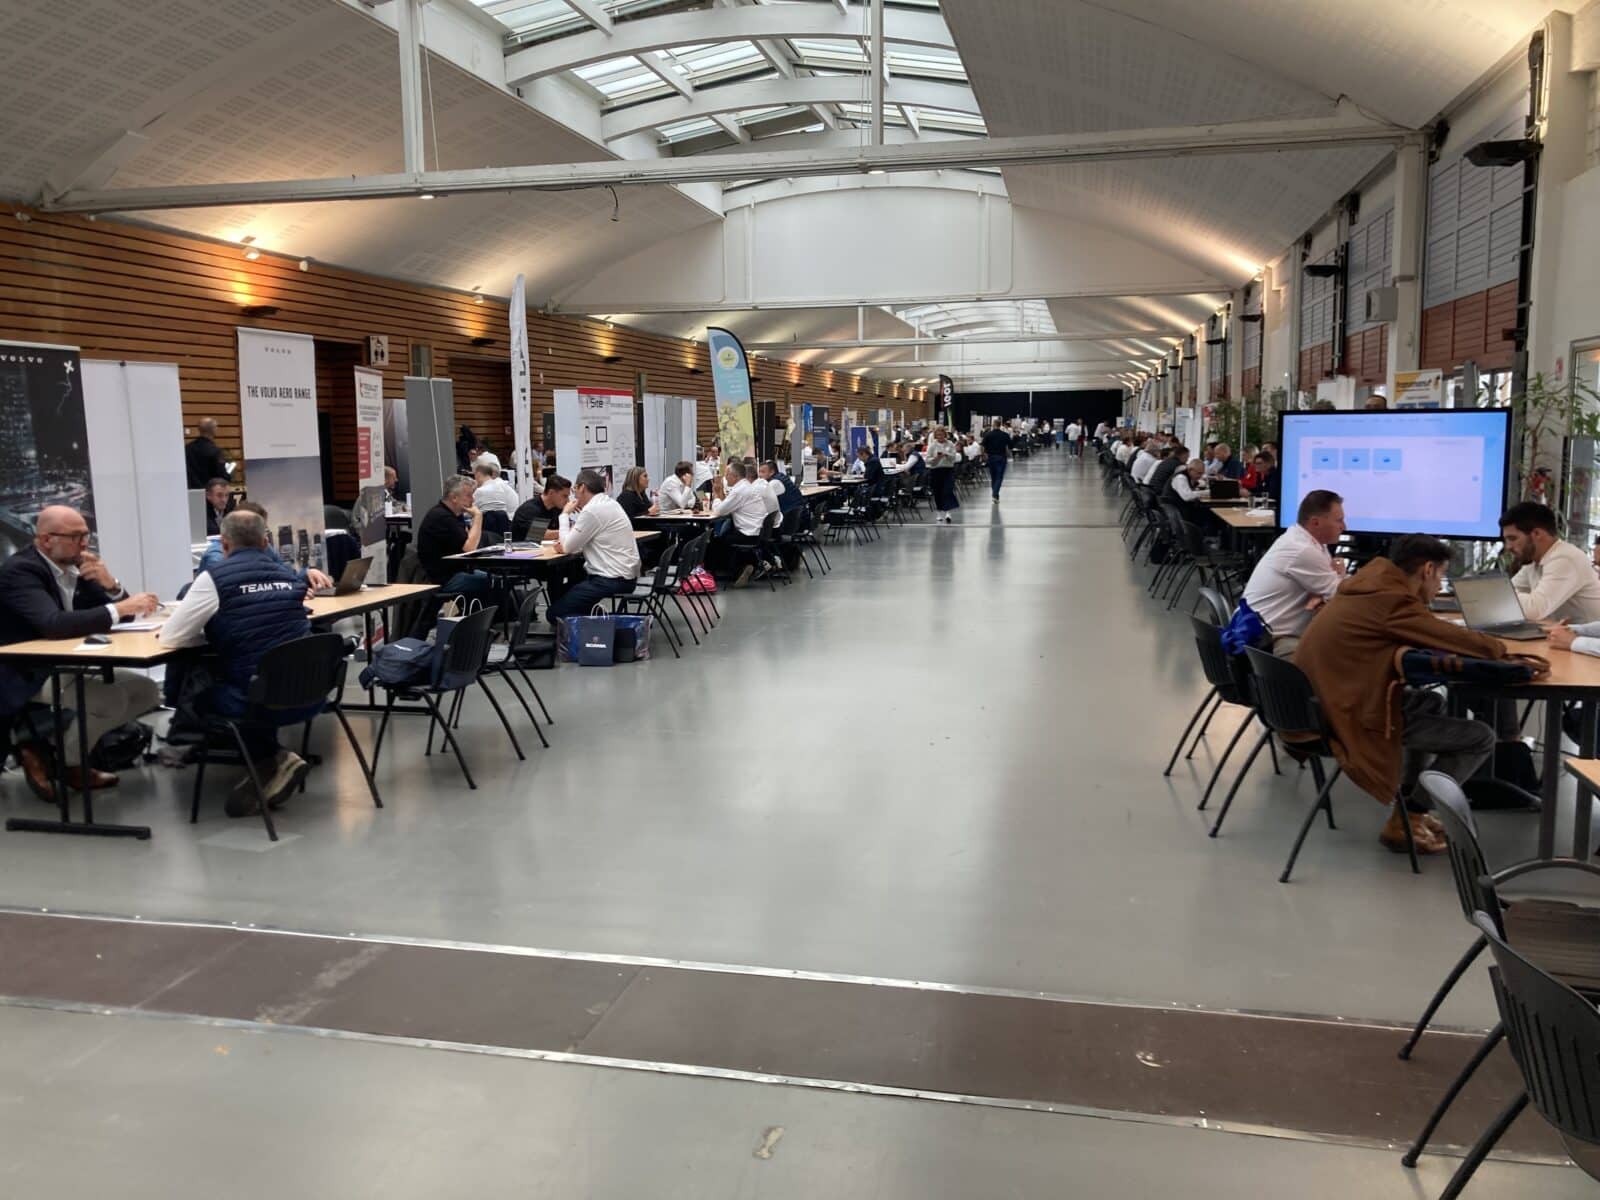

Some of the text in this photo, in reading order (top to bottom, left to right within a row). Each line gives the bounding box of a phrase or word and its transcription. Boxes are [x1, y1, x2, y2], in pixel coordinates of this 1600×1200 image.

[0, 354, 43, 364] VOLVO
[247, 385, 259, 398] THE
[260, 386, 278, 399] VOLVO
[294, 387, 312, 400] RANGE
[239, 583, 273, 595] TEAM
